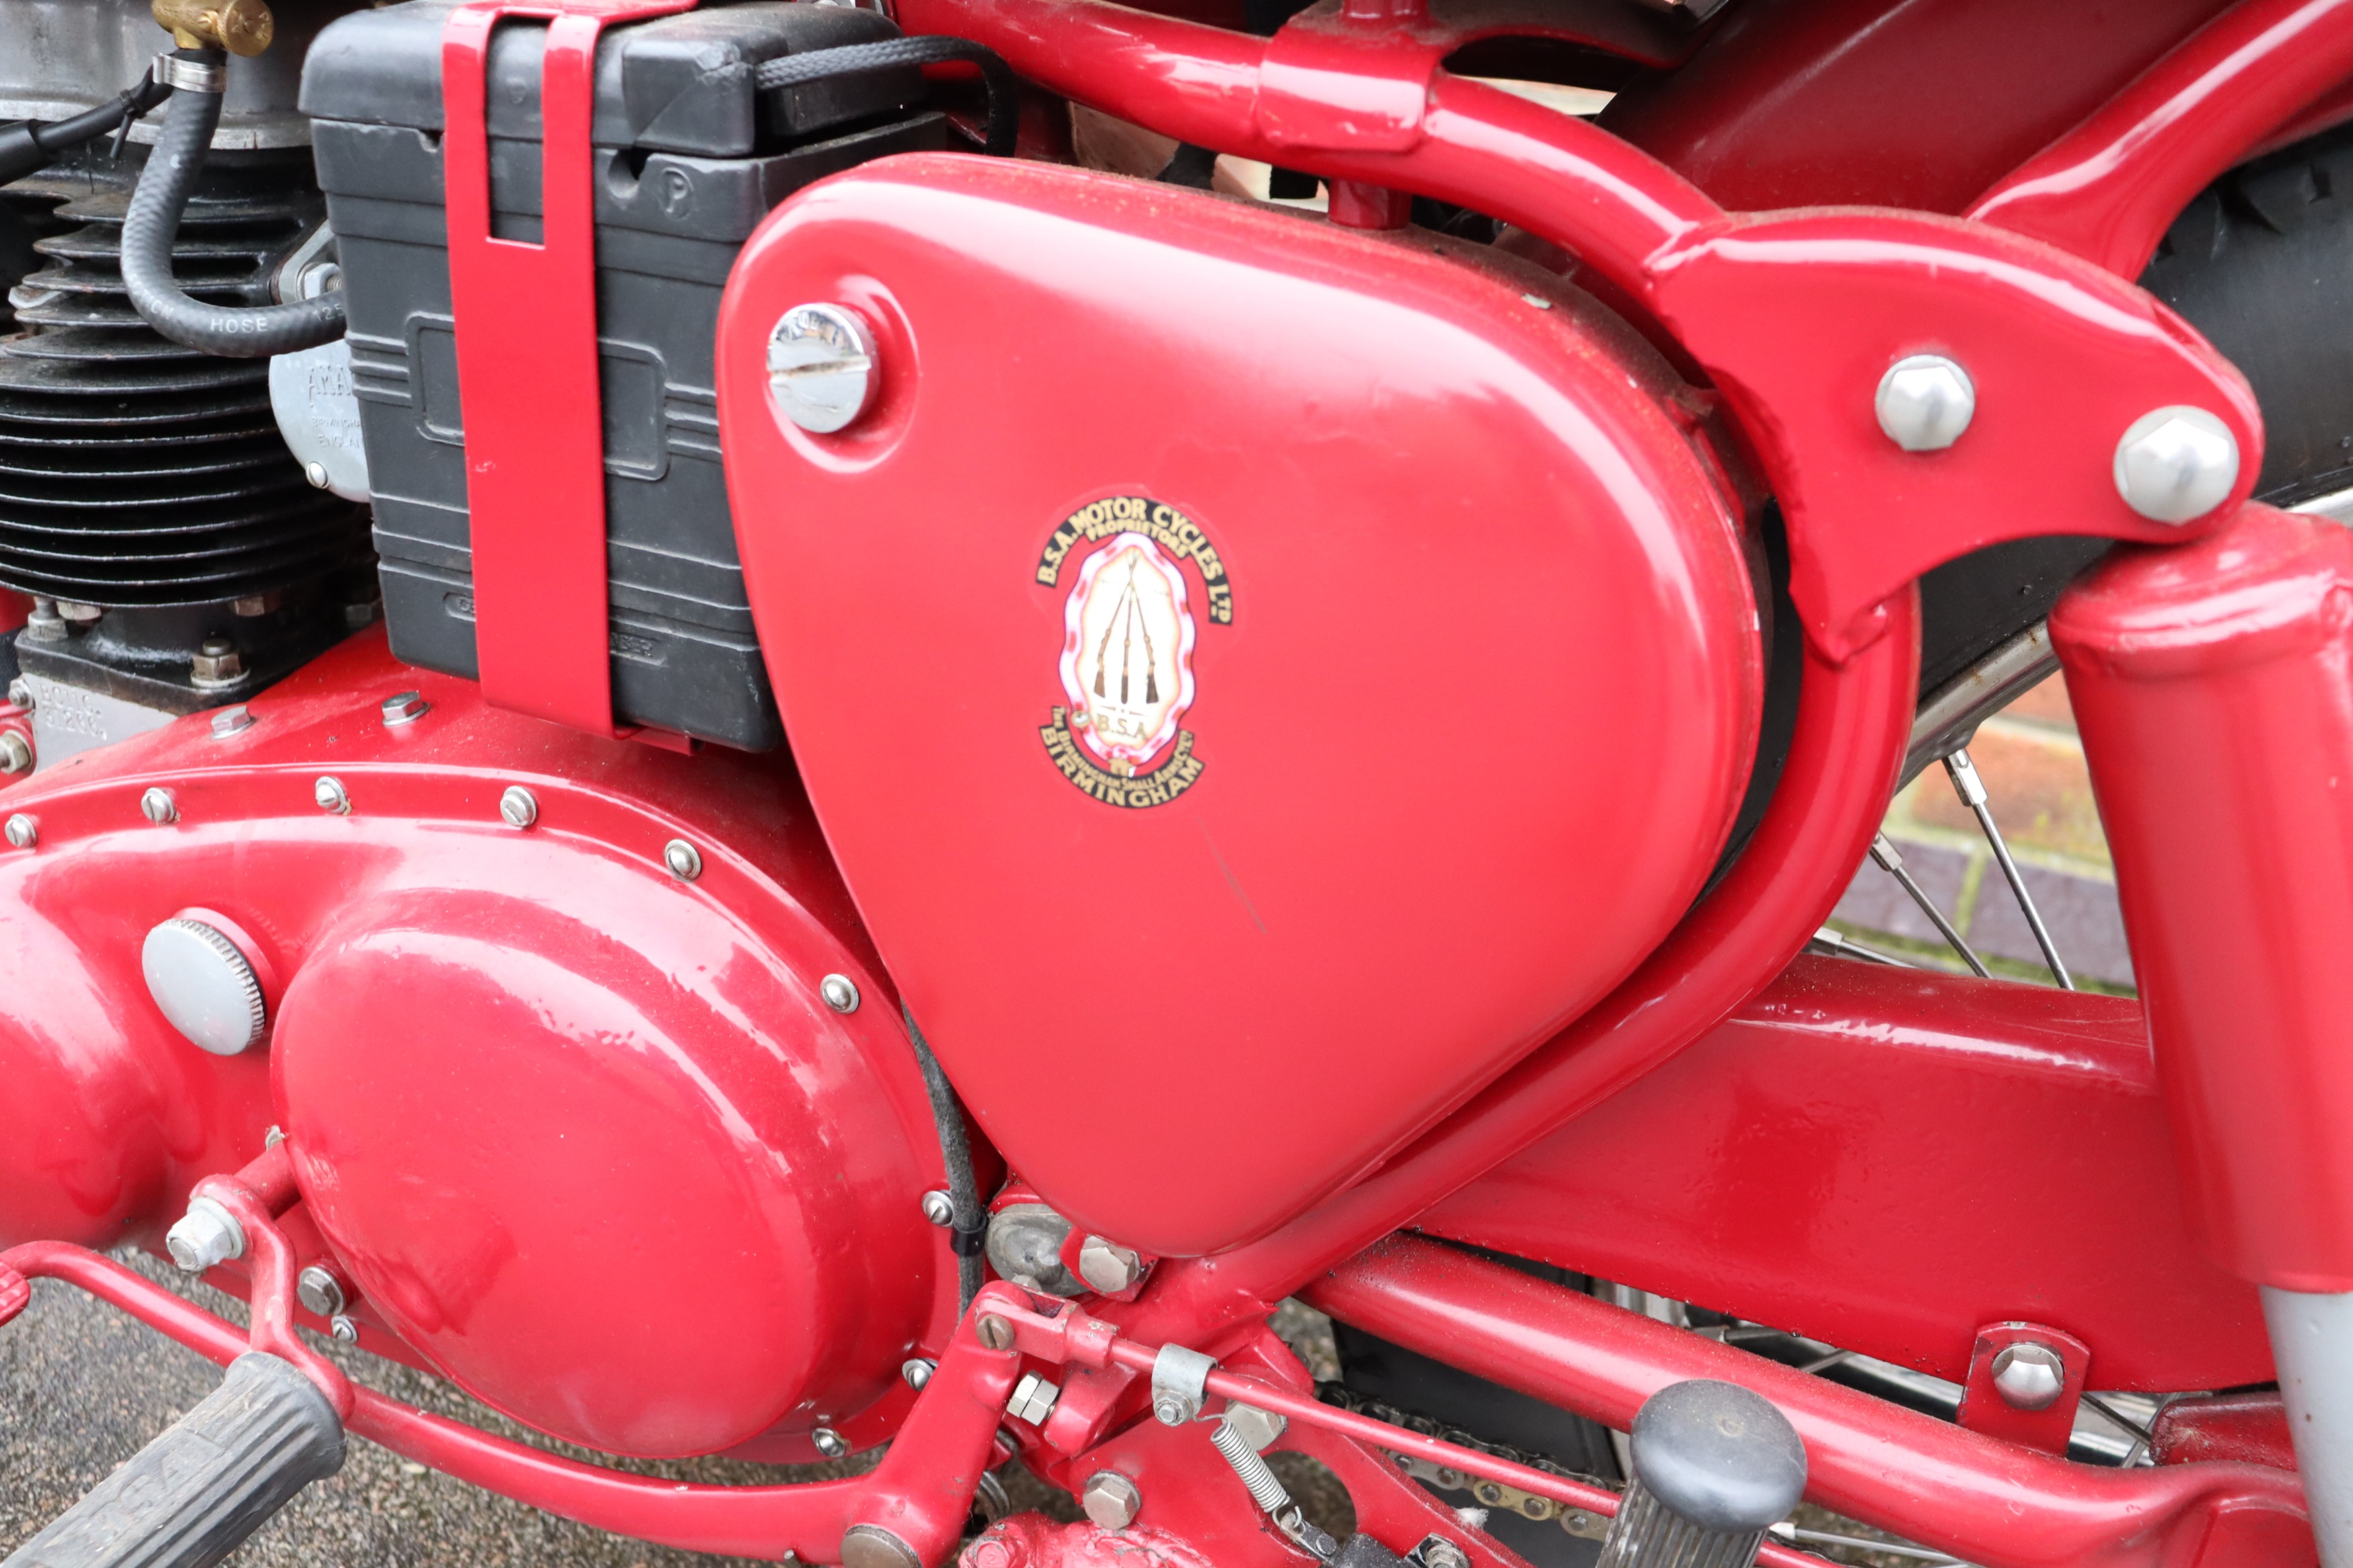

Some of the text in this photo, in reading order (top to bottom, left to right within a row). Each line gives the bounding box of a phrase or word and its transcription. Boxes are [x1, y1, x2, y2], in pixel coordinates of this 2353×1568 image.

[210, 317, 268, 333] HOSE
[309, 365, 354, 408] AMA
[312, 416, 362, 428] BIRMINGHA
[1068, 497, 1148, 535] MOTOR
[1152, 505, 1224, 581] CYCLES
[1085, 518, 1189, 559] PROPRIETORS
[1040, 726, 1204, 808] BIRMINGHAM
